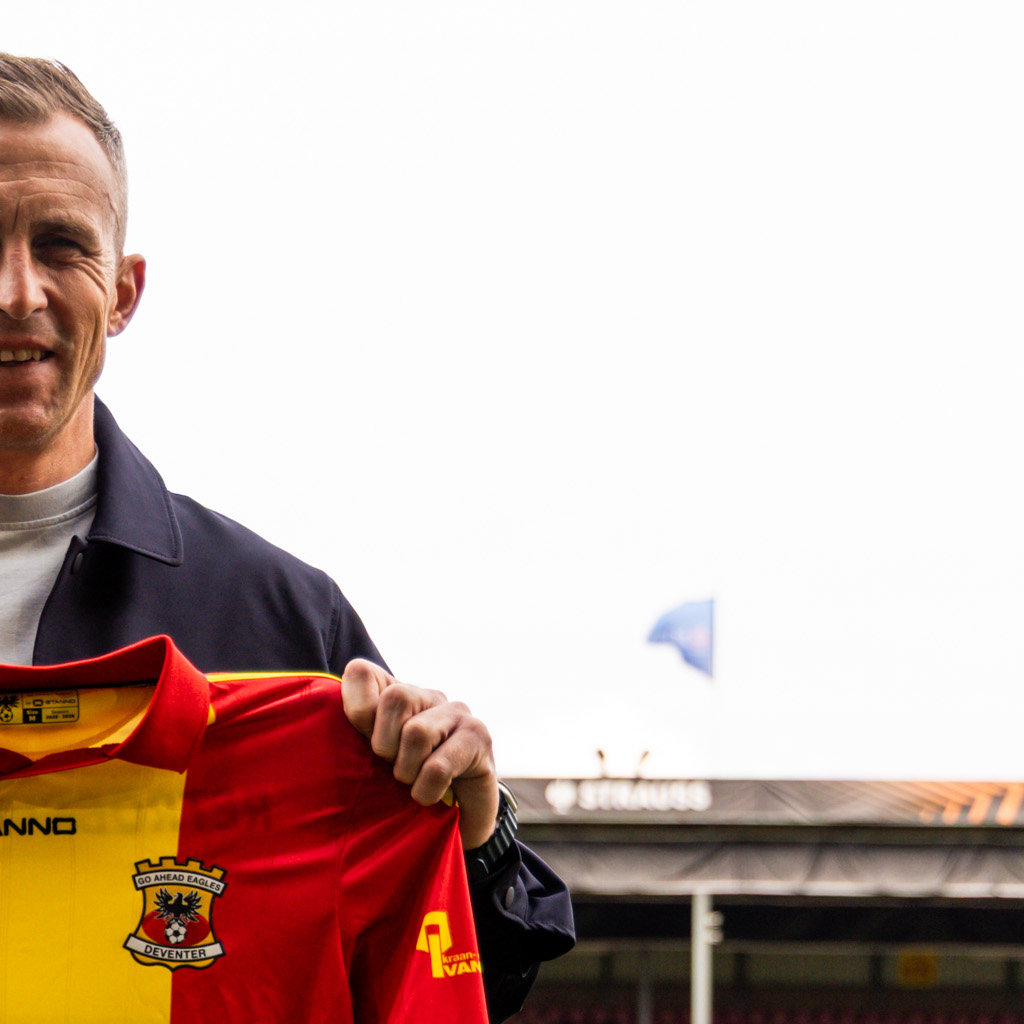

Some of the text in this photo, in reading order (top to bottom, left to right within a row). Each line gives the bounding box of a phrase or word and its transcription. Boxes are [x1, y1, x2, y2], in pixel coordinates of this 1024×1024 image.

[578, 779, 713, 811] STRAUSS
[137, 873, 221, 892] GO AHEAD EAGLES
[144, 945, 207, 959] DEVENTER
